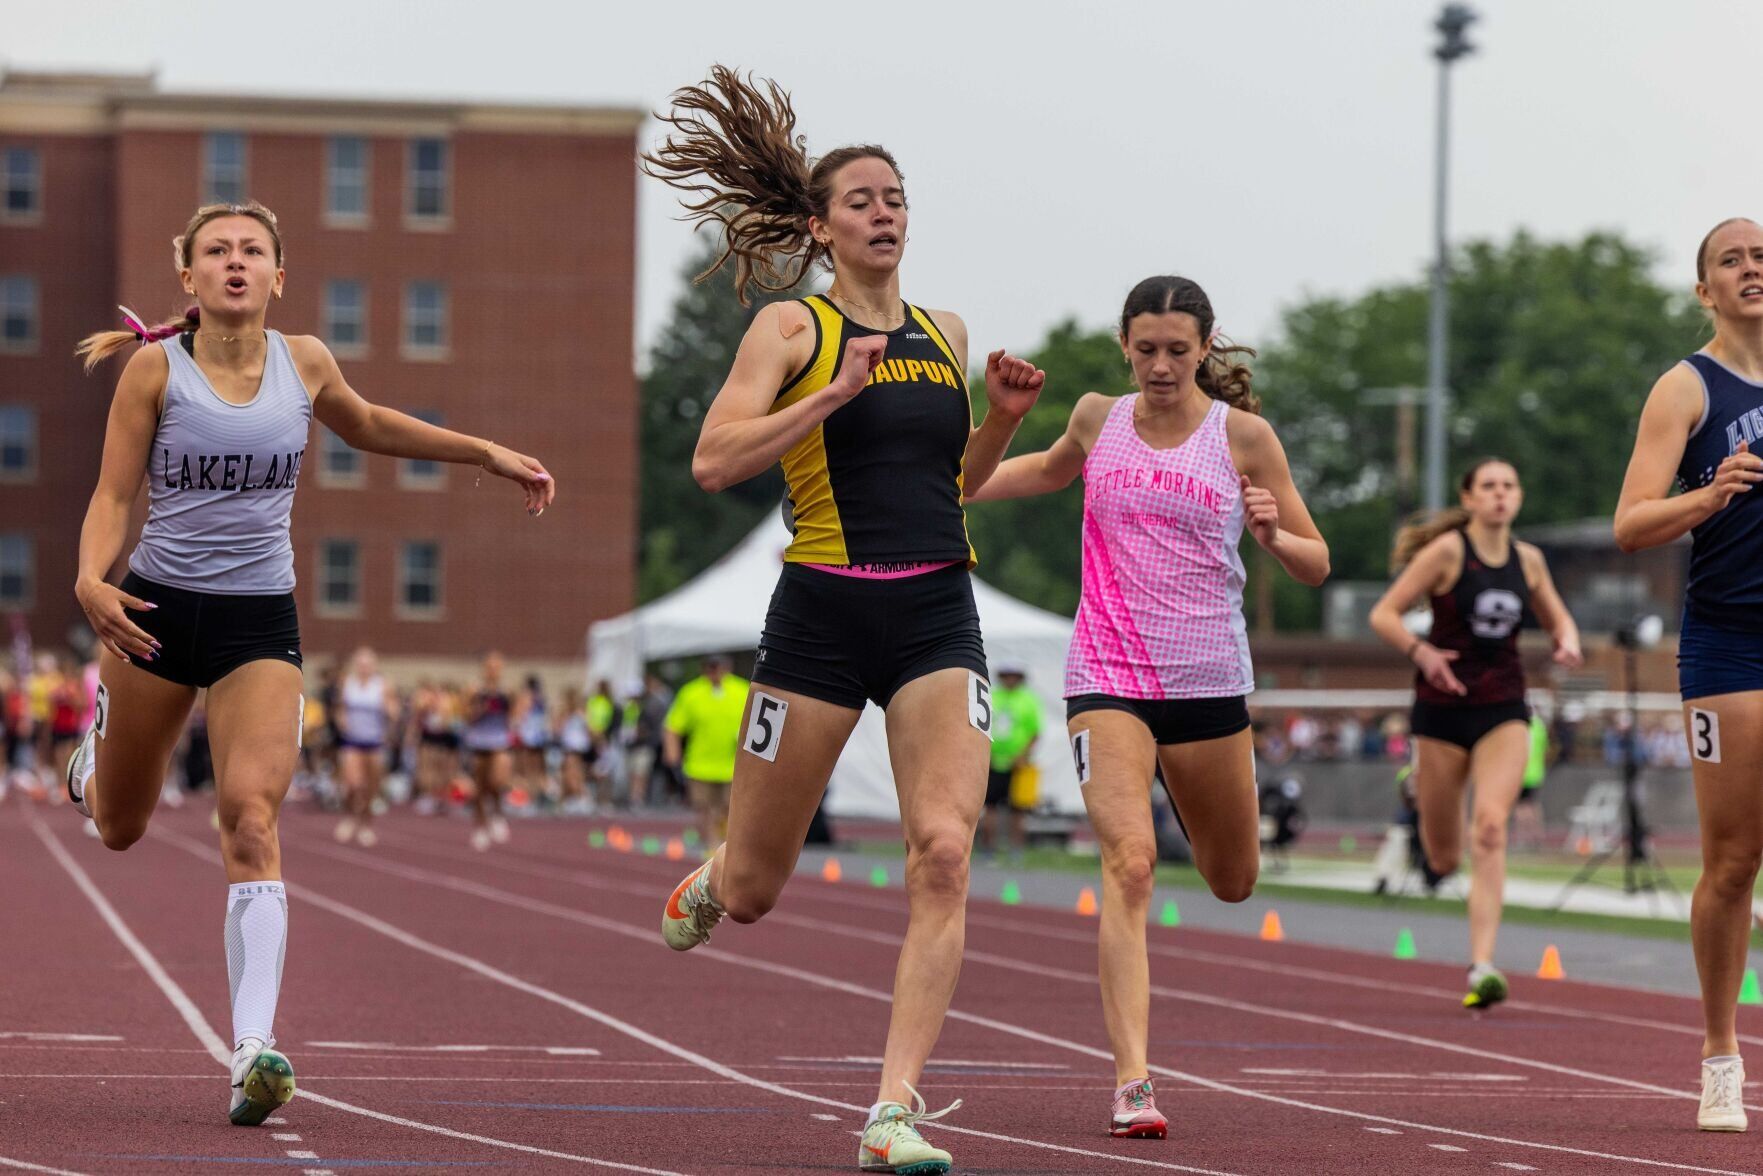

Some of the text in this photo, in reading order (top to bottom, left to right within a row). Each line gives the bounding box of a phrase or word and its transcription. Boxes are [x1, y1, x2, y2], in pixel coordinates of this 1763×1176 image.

[1726, 405, 1763, 457] LIG
[164, 448, 304, 491] LAKELAN
[1090, 468, 1221, 515] ETTLE MORAINE
[1121, 511, 1178, 529] LUTHERAN
[750, 697, 779, 753] 5
[976, 678, 991, 732] 5
[1696, 712, 1713, 759] 3
